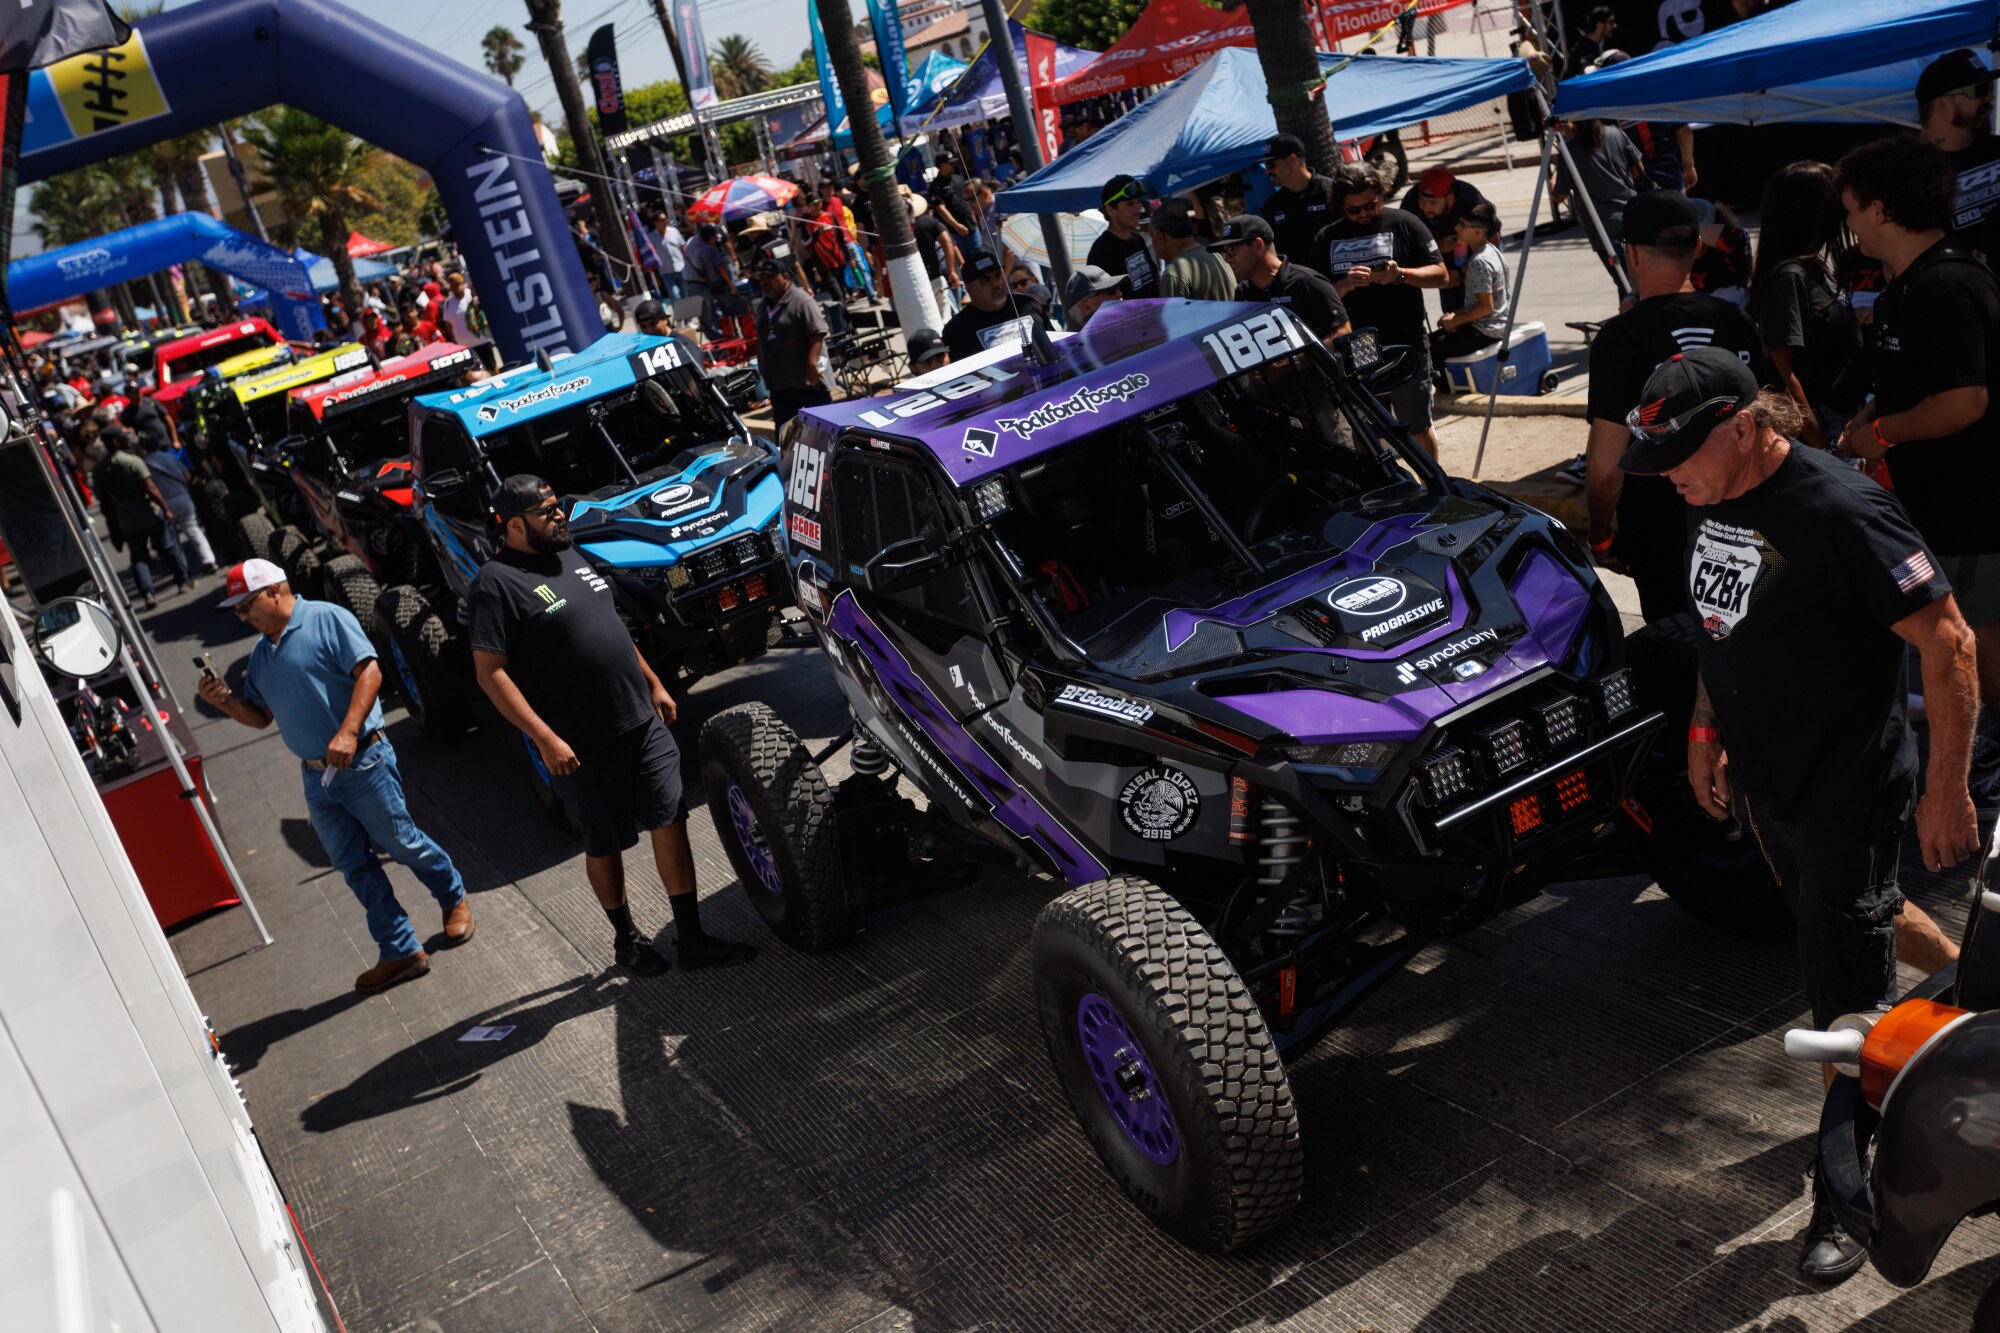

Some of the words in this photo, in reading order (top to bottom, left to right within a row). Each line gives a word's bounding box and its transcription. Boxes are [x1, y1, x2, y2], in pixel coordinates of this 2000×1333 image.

[465, 155, 573, 357] ILSTEIN
[638, 342, 682, 376] 141
[1202, 307, 1305, 375] 1821
[788, 441, 825, 513] 1821
[793, 515, 820, 541] SCORE
[1351, 587, 1400, 612] MOTORSPORTS
[1361, 597, 1445, 643] PROGRESSIVE
[1415, 627, 1499, 671] synchrony
[1058, 684, 1154, 721] BFGoodrich
[898, 722, 974, 809] PROGRESSIVE
[1120, 768, 1160, 804] ANIBAL
[1163, 768, 1199, 805] LÓPEZ
[1142, 828, 1172, 840] 3919
